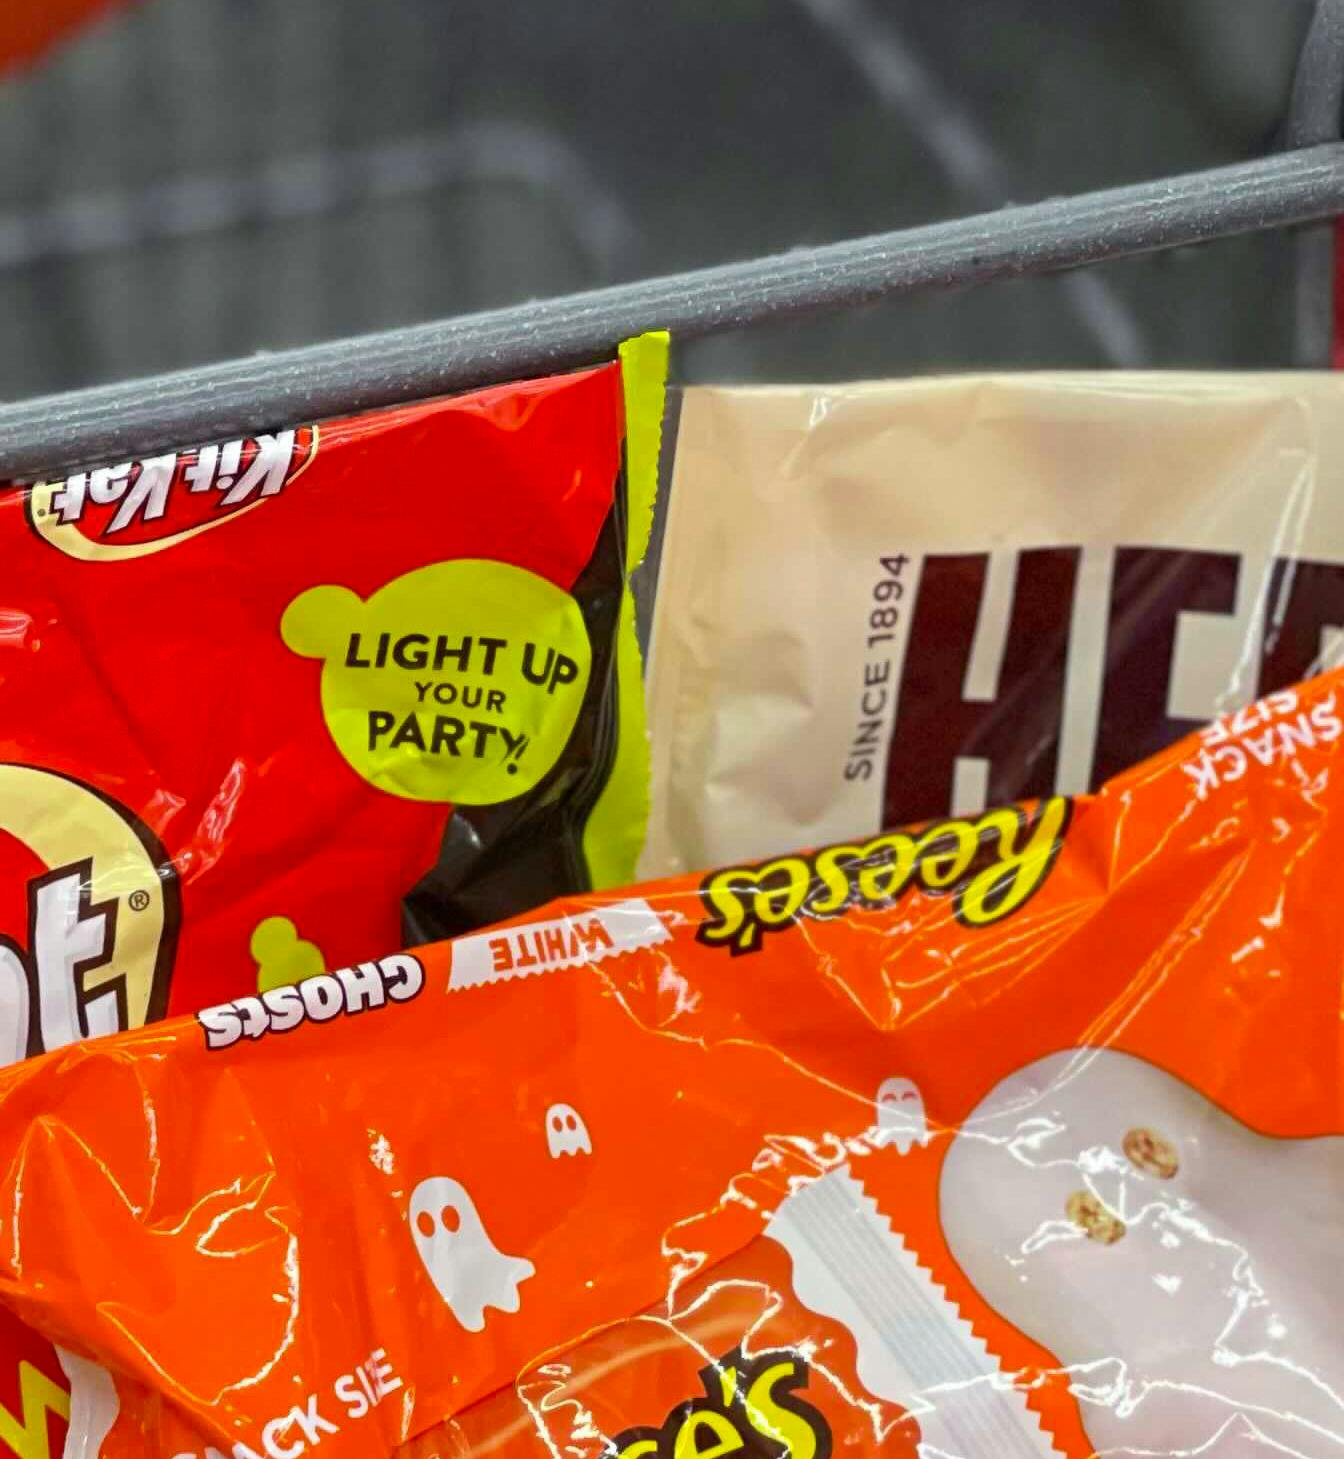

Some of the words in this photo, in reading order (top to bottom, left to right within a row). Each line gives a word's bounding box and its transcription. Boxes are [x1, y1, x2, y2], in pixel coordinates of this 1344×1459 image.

[344, 632, 508, 676] LIGHT
[520, 642, 579, 695] UP
[414, 681, 507, 714] YOUR
[843, 660, 891, 782] SINCE
[867, 553, 910, 648] 1894
[367, 710, 530, 776] PARTY!
[1180, 690, 1343, 800] SNACK
[696, 796, 1073, 955] Reese's
[489, 917, 616, 973] WHITE
[334, 1347, 403, 1419] SIE
